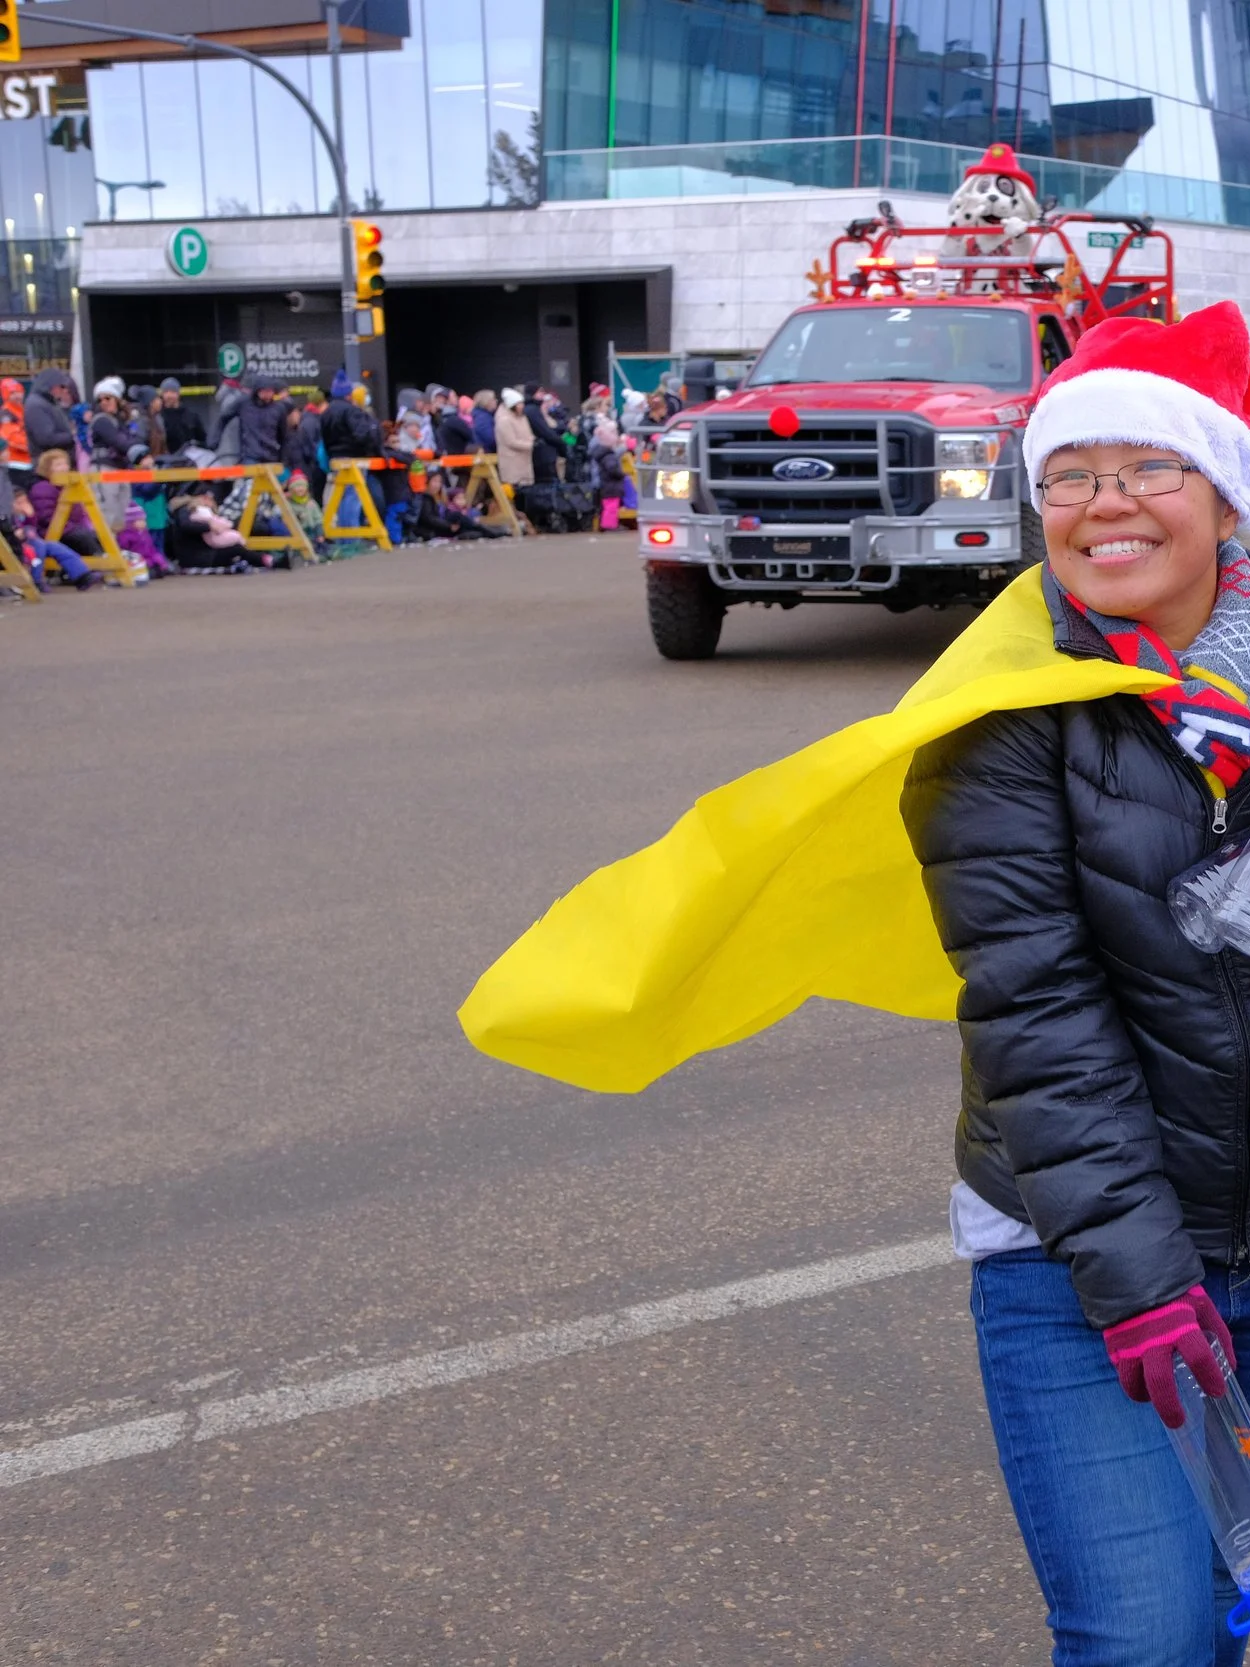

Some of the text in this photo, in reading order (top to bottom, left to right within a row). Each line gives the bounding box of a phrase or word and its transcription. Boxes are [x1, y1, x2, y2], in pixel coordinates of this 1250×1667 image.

[0, 75, 56, 119] ST
[180, 235, 200, 269] P
[886, 308, 912, 322] 2
[246, 342, 304, 359] PUBLIC
[246, 359, 320, 377] PARKING
